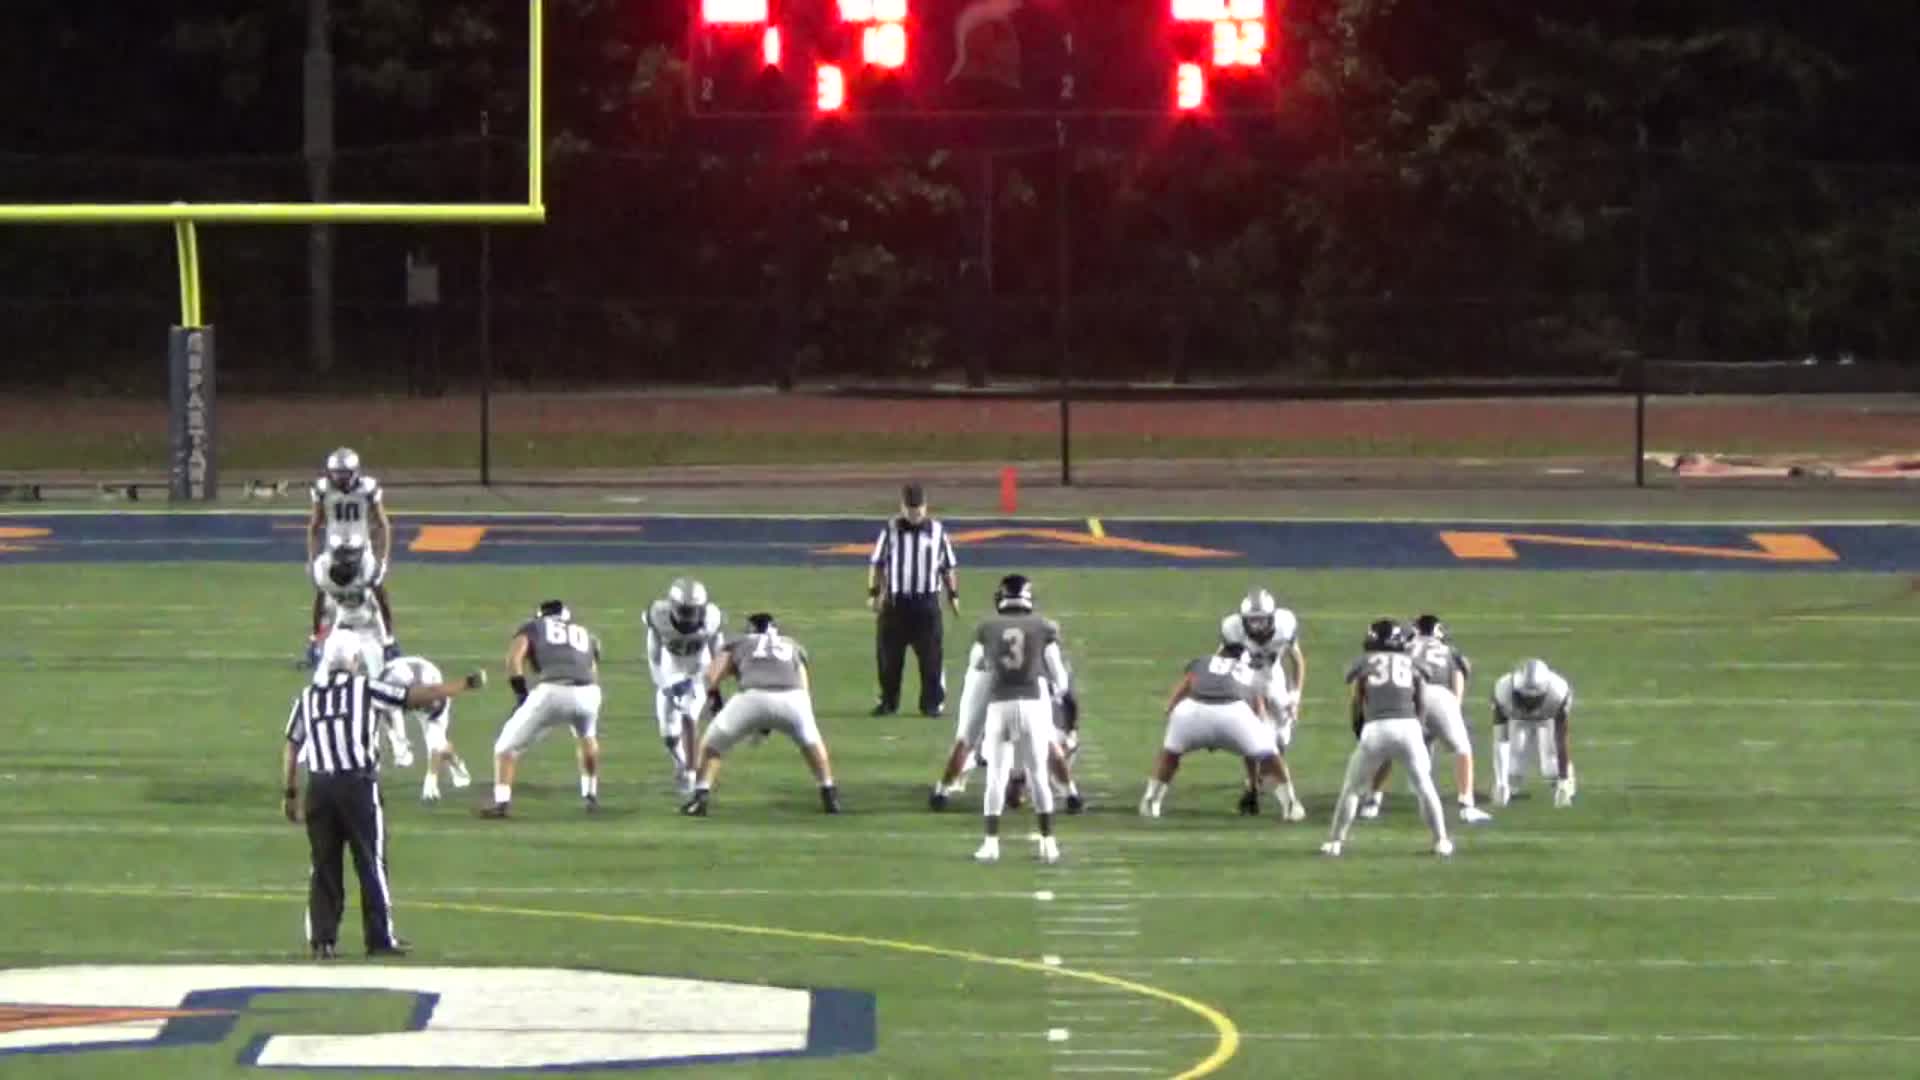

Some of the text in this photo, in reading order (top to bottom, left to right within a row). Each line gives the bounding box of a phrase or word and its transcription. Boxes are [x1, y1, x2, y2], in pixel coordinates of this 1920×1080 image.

[816, 65, 843, 110] 3
[1177, 63, 1204, 110] 3
[545, 617, 590, 652] 60
[1001, 628, 1026, 671] 3
[1366, 652, 1413, 688] 36
